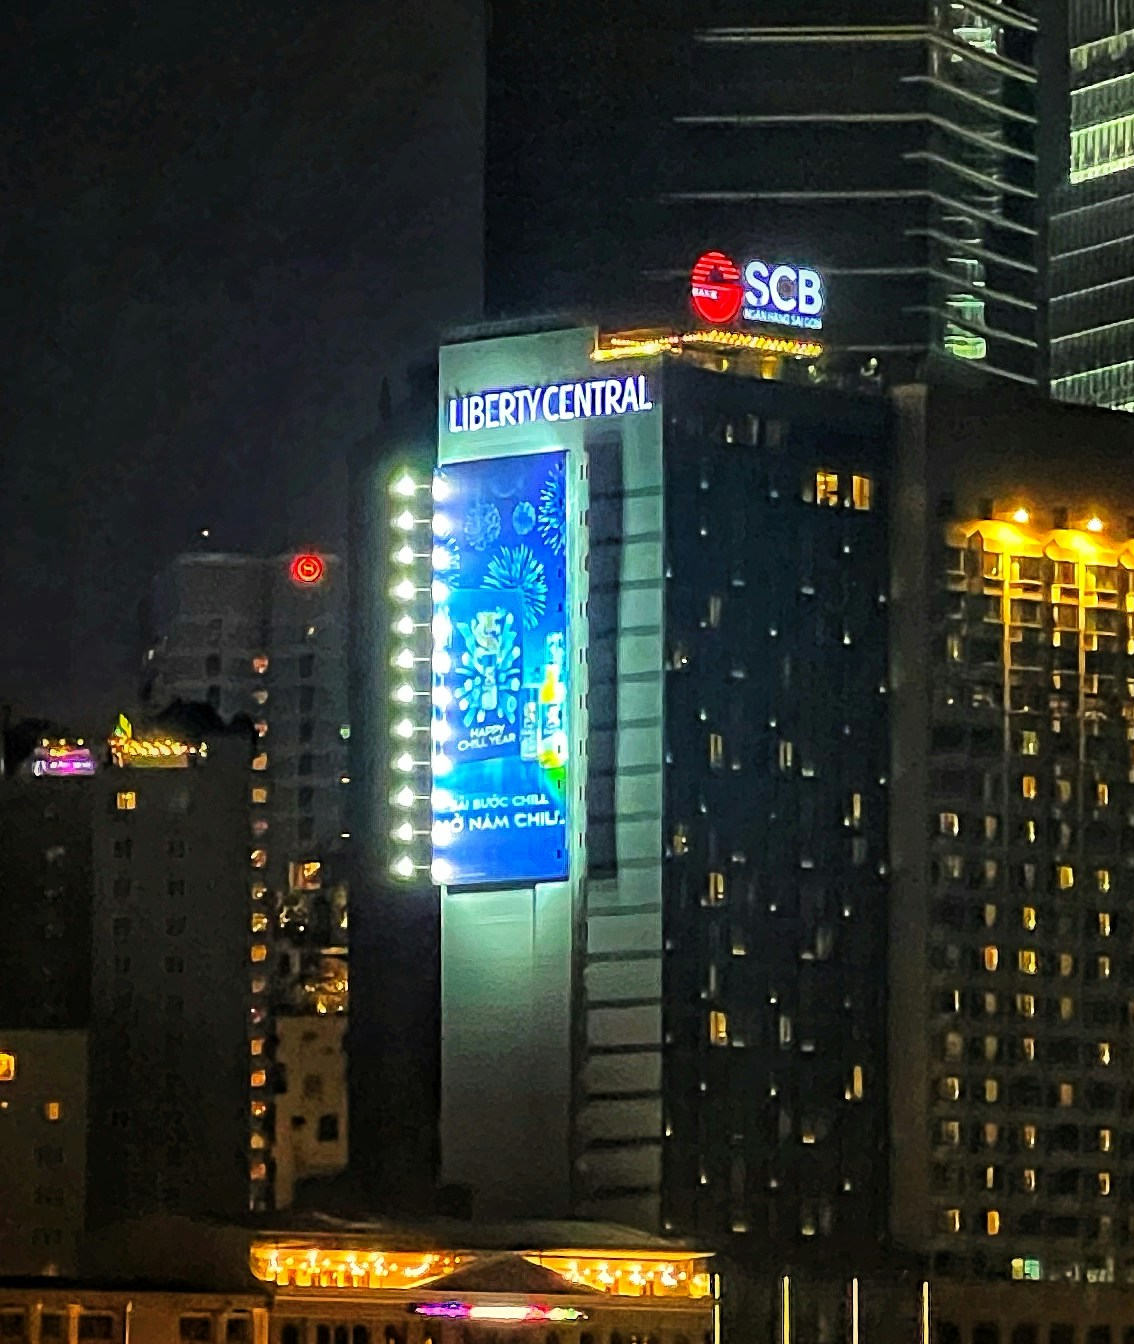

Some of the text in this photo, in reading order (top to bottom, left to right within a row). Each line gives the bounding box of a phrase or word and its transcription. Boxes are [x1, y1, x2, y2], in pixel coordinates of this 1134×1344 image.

[744, 260, 823, 315] SCB
[449, 374, 653, 433] LIBERTY CENTRAL
[470, 724, 505, 737] HAPPY
[458, 732, 516, 751] CHILL YEAR
[512, 794, 549, 807] CHILL
